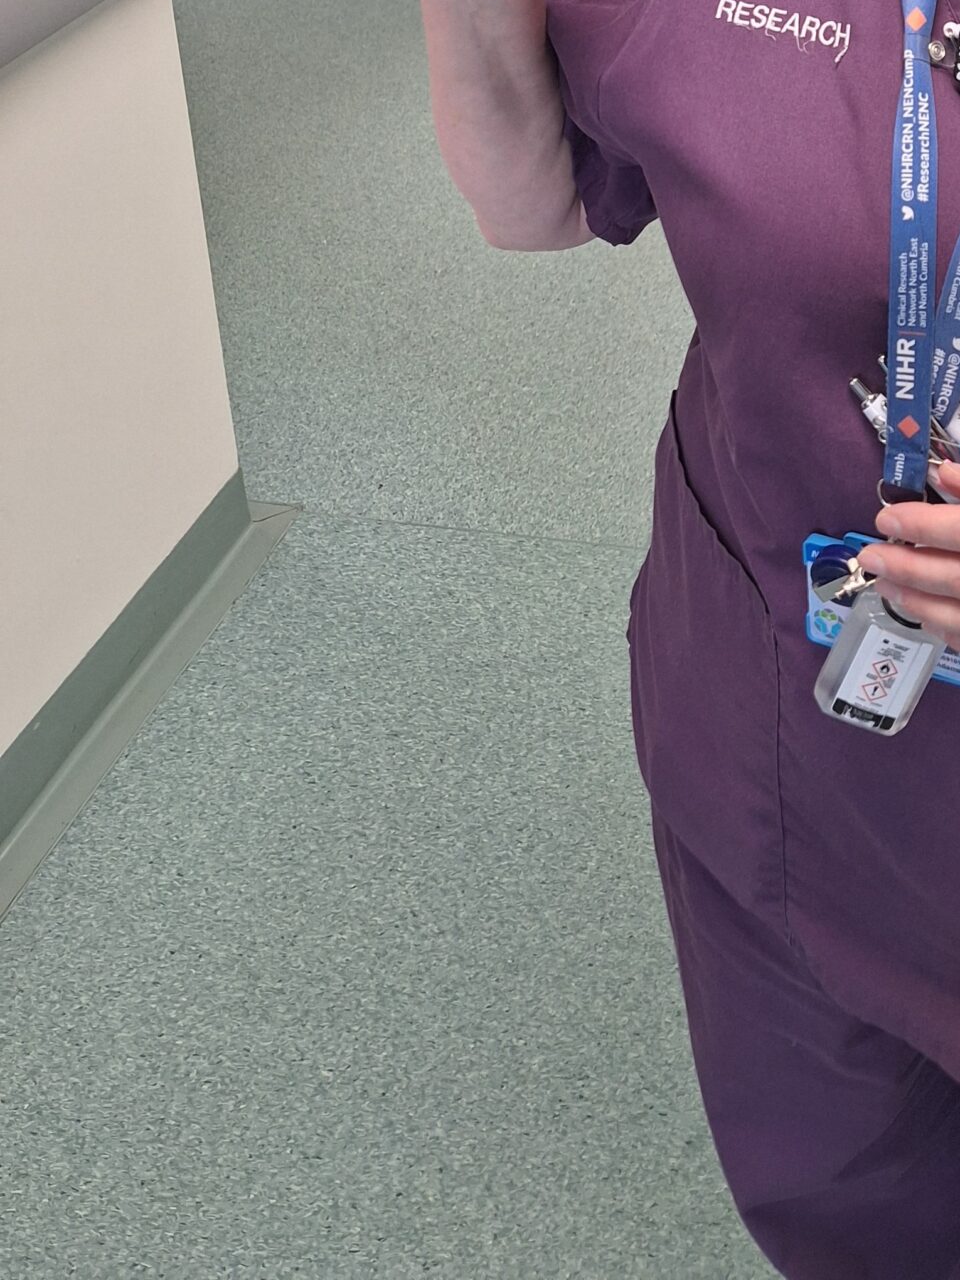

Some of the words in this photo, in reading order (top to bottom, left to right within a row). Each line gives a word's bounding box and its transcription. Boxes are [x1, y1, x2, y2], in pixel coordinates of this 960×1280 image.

[917, 91, 930, 203] #ResearchNENC
[909, 237, 918, 257] East
[919, 241, 928, 281] Cumbria
[897, 252, 909, 293] Research
[908, 259, 917, 286] North
[896, 294, 906, 326] Clinical
[907, 288, 916, 326] Network
[918, 282, 927, 309] North
[945, 276, 960, 313] Cumbria
[895, 338, 916, 401] NIHR
